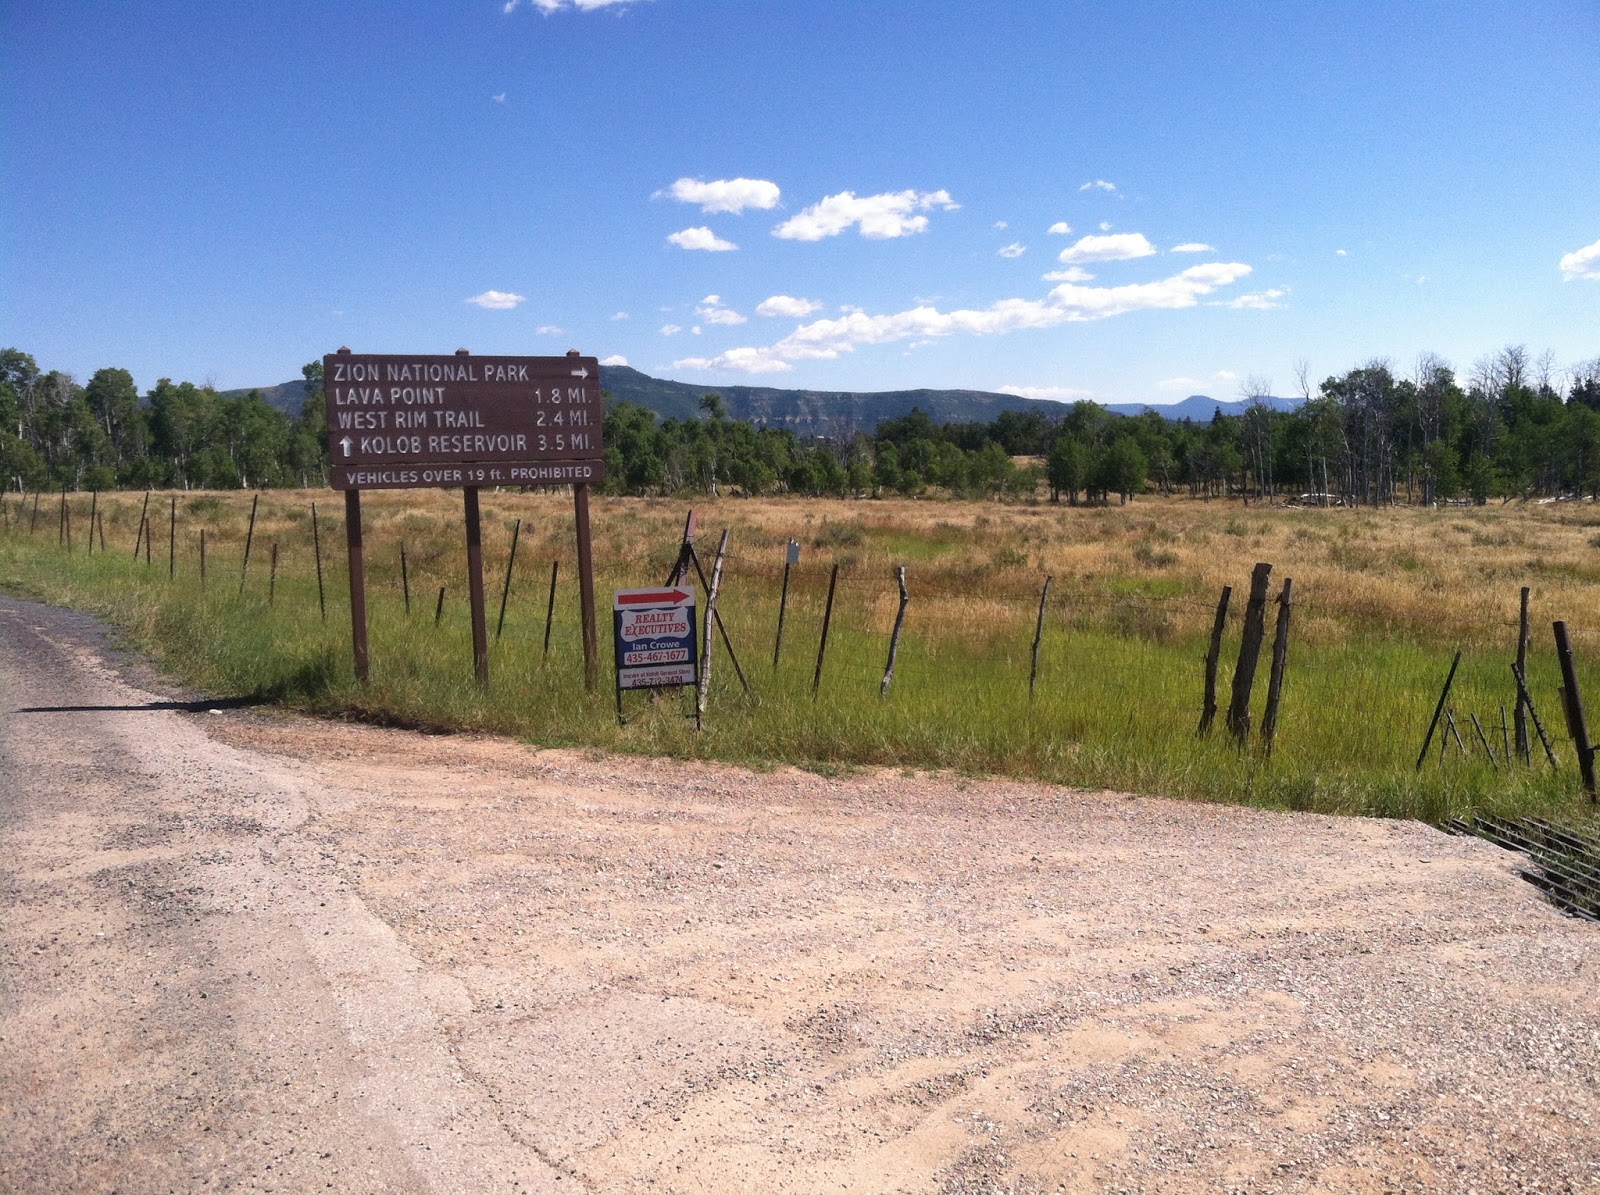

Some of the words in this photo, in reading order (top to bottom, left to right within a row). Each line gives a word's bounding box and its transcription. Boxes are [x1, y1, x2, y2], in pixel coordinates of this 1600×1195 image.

[334, 364, 380, 382] ZION
[387, 363, 478, 381] NATIONAL
[484, 365, 530, 381] PARK
[336, 388, 384, 405] LAVA
[390, 387, 445, 405] POINT
[535, 388, 561, 404] 1.8
[568, 388, 592, 404] MI.
[337, 411, 388, 429] WEST
[395, 411, 427, 429] RIM
[433, 410, 485, 428] TRAIL
[536, 410, 564, 427] 2.4
[569, 410, 593, 427] MI.
[361, 436, 422, 454] KOLOB
[429, 434, 527, 453] RESERVOIR
[538, 434, 565, 451] 3.5
[571, 433, 595, 451] MI.
[346, 470, 418, 485] VEHICLES
[423, 469, 462, 482] OVER
[467, 469, 485, 481] 19
[489, 468, 505, 480] ft.
[511, 467, 592, 480] PROHIBITED
[635, 613, 675, 624] REALTY
[625, 623, 686, 637] EXECUTIVES
[650, 642, 680, 650] Crowe
[627, 650, 686, 663] 435-467-1677
